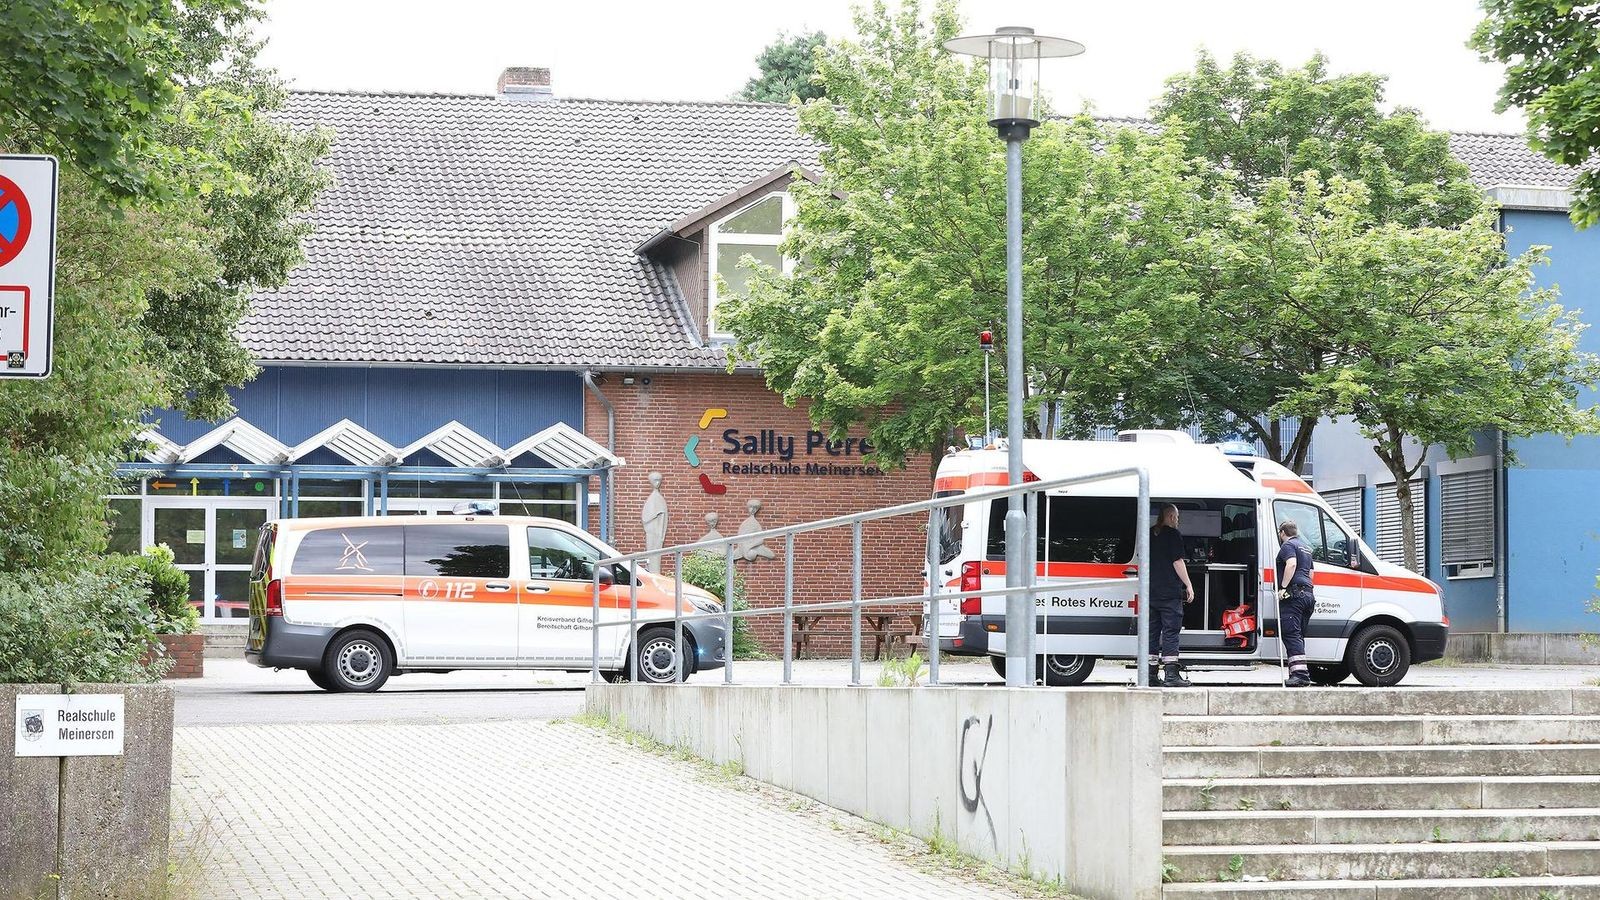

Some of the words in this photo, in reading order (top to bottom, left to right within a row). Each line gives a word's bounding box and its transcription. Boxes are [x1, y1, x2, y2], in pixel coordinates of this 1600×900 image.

[722, 428, 794, 461] Sally
[806, 431, 876, 456] Pere
[722, 462, 801, 475] Realschule
[445, 582, 477, 599] 112
[1051, 596, 1086, 608] Rotes
[1089, 597, 1124, 608] Kreuz
[536, 622, 572, 630] Bereitschaft
[577, 616, 594, 624] Gifho
[57, 709, 116, 722] Realschule
[58, 727, 114, 740] Meinersen
